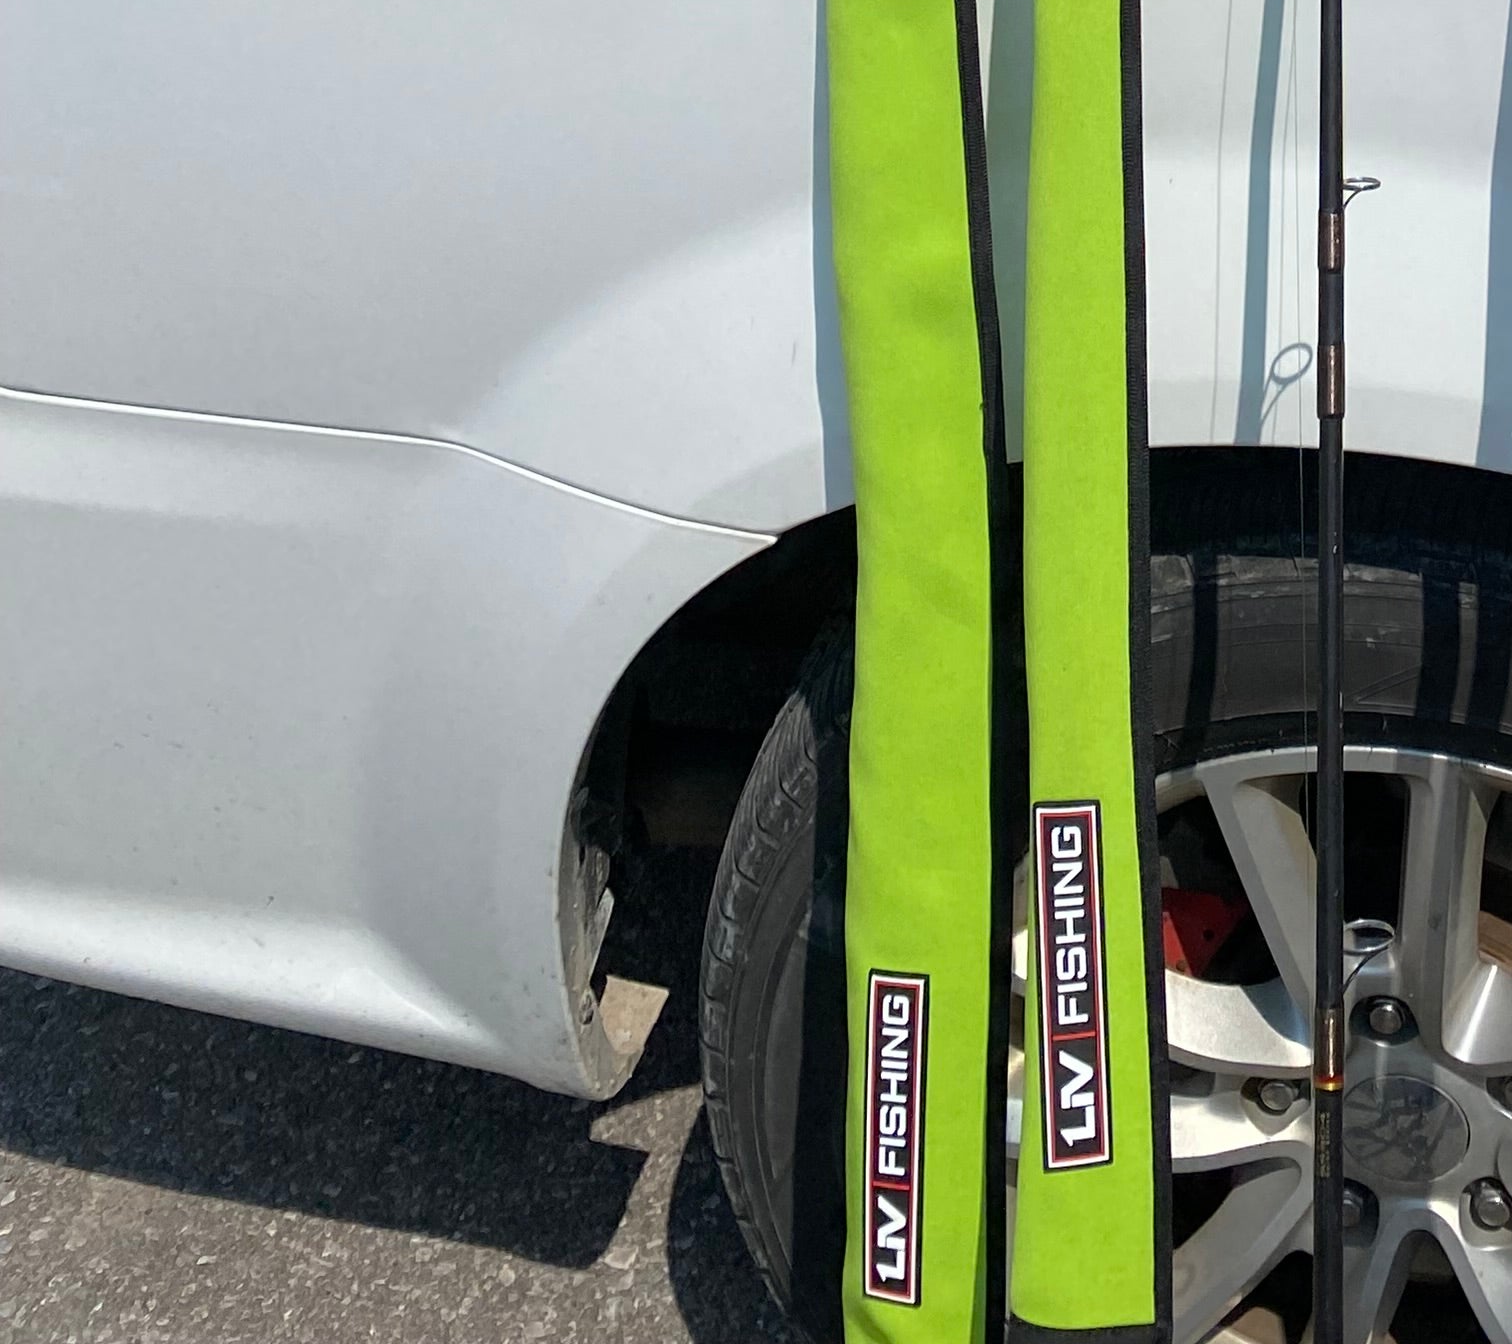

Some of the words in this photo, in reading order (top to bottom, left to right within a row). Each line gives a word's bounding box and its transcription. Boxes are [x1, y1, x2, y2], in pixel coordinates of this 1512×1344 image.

[1050, 824, 1090, 1027] FISHING
[877, 992, 911, 1178] FISHING
[1057, 1050, 1096, 1147] LIV
[875, 1195, 908, 1284] LIV
